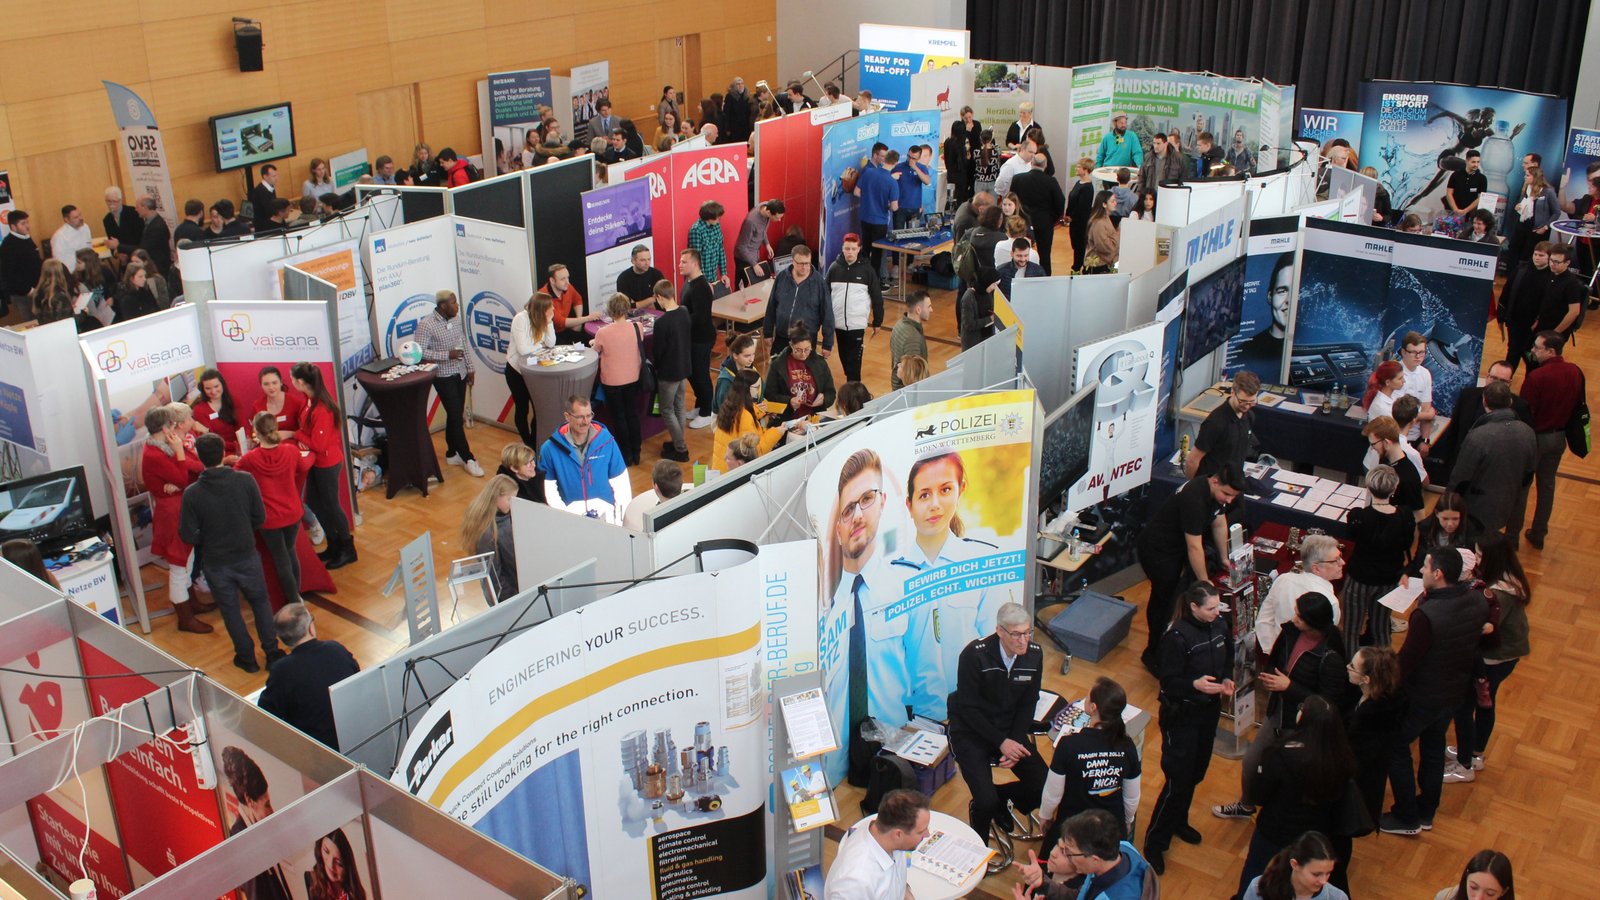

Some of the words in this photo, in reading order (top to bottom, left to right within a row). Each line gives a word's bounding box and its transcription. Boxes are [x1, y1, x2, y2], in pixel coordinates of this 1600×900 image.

[864, 55, 890, 65] READY
[893, 58, 910, 67] FOR
[864, 65, 910, 76] TAKE-OFF?
[1114, 78, 1256, 108] ANDSCHAFTSGÄRTNER
[1382, 94, 1428, 102] ENSINGER
[1144, 103, 1155, 112] die
[1156, 104, 1175, 114] Welt.
[1304, 114, 1338, 131] WIR
[1304, 128, 1336, 137] SUCHEN
[682, 157, 740, 189] AERA
[645, 172, 667, 200] RA
[588, 214, 612, 226] Entdecke
[588, 226, 604, 236] deine
[604, 219, 626, 232] Stärken!
[1186, 218, 1235, 266] MAHLE
[1364, 242, 1394, 253] MAHLE
[1458, 257, 1490, 268] MAHLE
[342, 288, 357, 300] DBV
[251, 333, 319, 346] vaisana
[127, 344, 192, 371] vaisana
[342, 345, 374, 378] OLIZEI
[940, 414, 997, 433] POLIZEI
[914, 434, 996, 455] BADEN-WÜRTTEMBERG
[1087, 458, 1142, 491] AVNTEC
[908, 570, 948, 590] BEWIRB
[950, 561, 979, 576] DICH
[982, 553, 1022, 569] JETZT!
[68, 582, 92, 596] Netze
[93, 574, 106, 586] BW
[888, 594, 927, 618] POLIZEI.
[930, 584, 962, 598] ECHT.
[966, 571, 1020, 588] WICHTIG.
[488, 644, 582, 706] ENGINEERING
[585, 626, 624, 652] YOUR
[628, 606, 705, 635] SUCCESS.
[409, 726, 452, 792] Parker
[471, 787, 492, 812] still
[494, 753, 532, 793] looking
[534, 741, 552, 759] for
[556, 730, 578, 746] the
[582, 711, 613, 736] right
[616, 688, 698, 718] connection.
[462, 778, 486, 803] Connect
[486, 758, 512, 782] Coupling
[512, 737, 537, 760] Solutions
[1086, 760, 1108, 769] DANN
[1094, 777, 1118, 788] MICH.
[37, 804, 79, 848] Starten
[658, 830, 692, 843] aerospace
[658, 840, 682, 851] climate
[683, 834, 706, 844] control
[44, 832, 64, 856] mit
[64, 848, 81, 869] un
[658, 840, 718, 858] electromechanical
[659, 854, 686, 866] filtration
[660, 865, 674, 875] fluid
[681, 860, 694, 868] gas
[694, 854, 722, 864] handling
[660, 868, 693, 882] hydraulics
[660, 875, 698, 891] pneumatics
[662, 884, 686, 899] process
[686, 880, 710, 890] control
[692, 886, 722, 896] shielding
